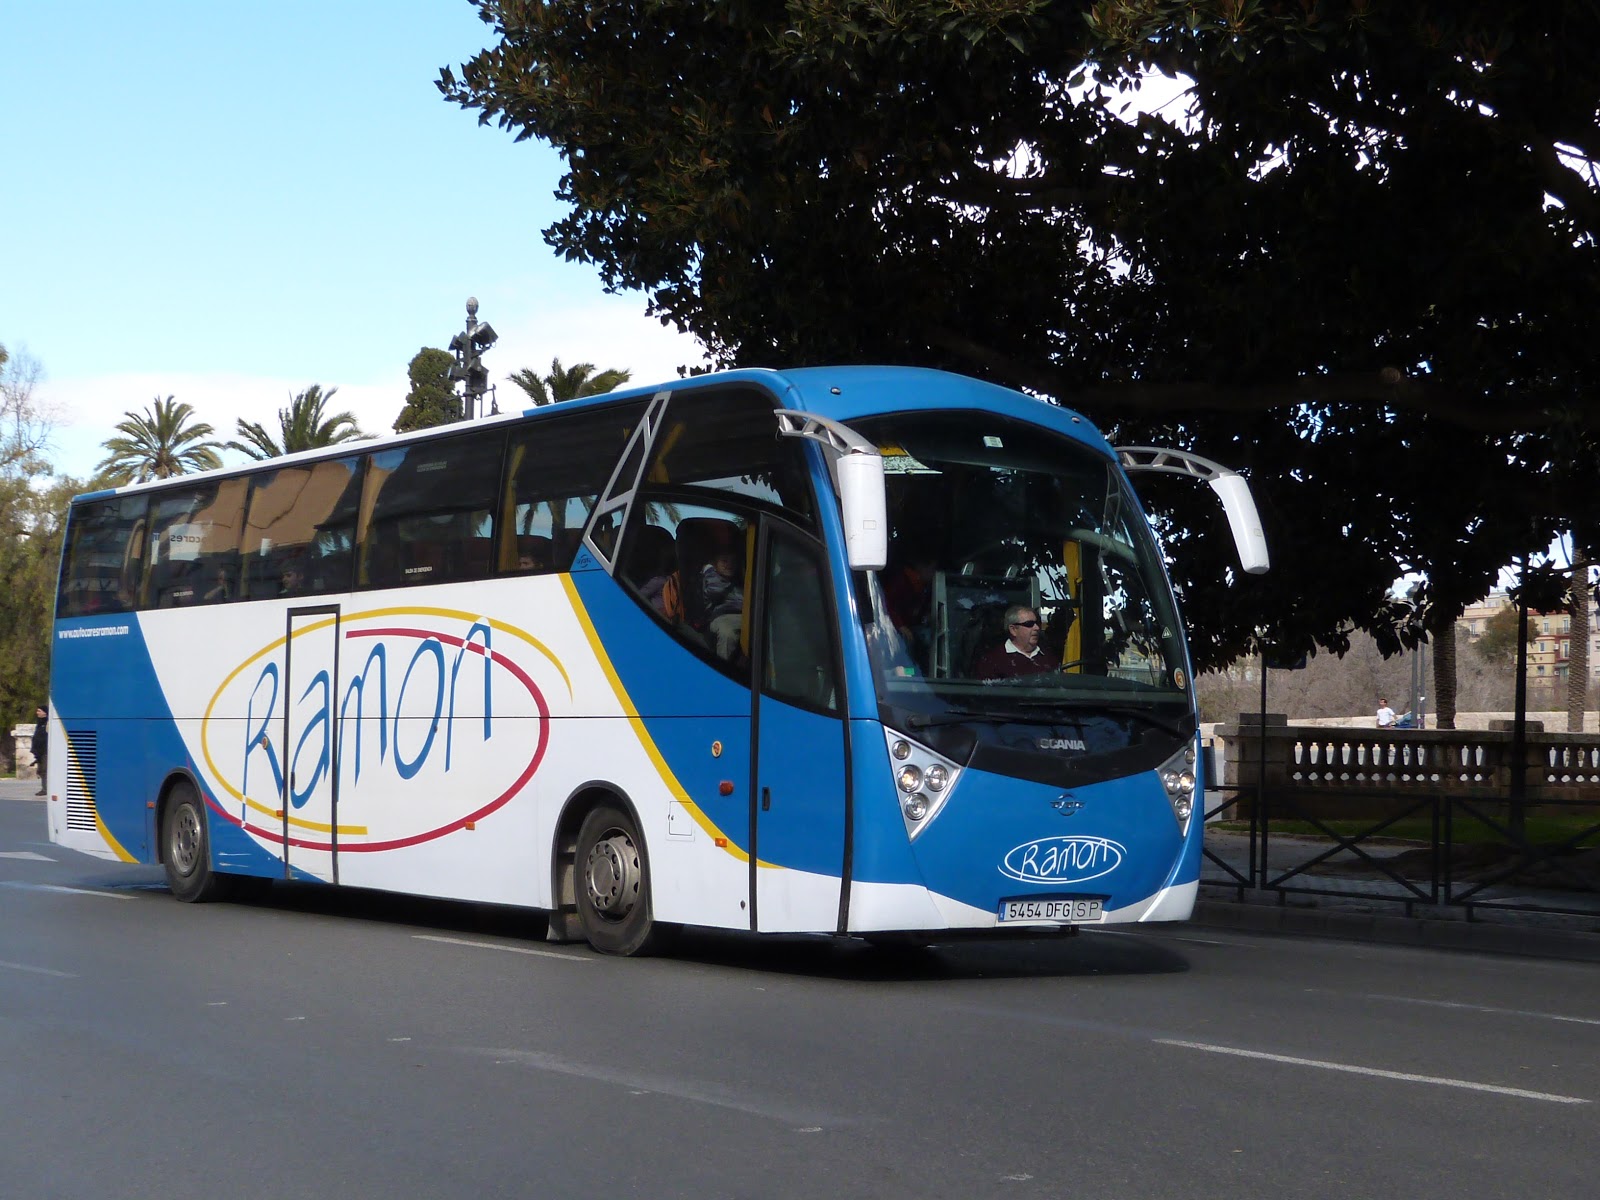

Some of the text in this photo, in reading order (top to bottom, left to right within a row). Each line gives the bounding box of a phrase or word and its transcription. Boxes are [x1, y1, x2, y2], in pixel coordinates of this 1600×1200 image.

[58, 626, 129, 639] www.autocaresramon.com
[241, 617, 491, 828] Ramon
[1040, 738, 1086, 751] SCANIA
[1020, 839, 1108, 880] Ramon
[1009, 903, 1042, 918] 5454
[1046, 902, 1070, 918] DFG
